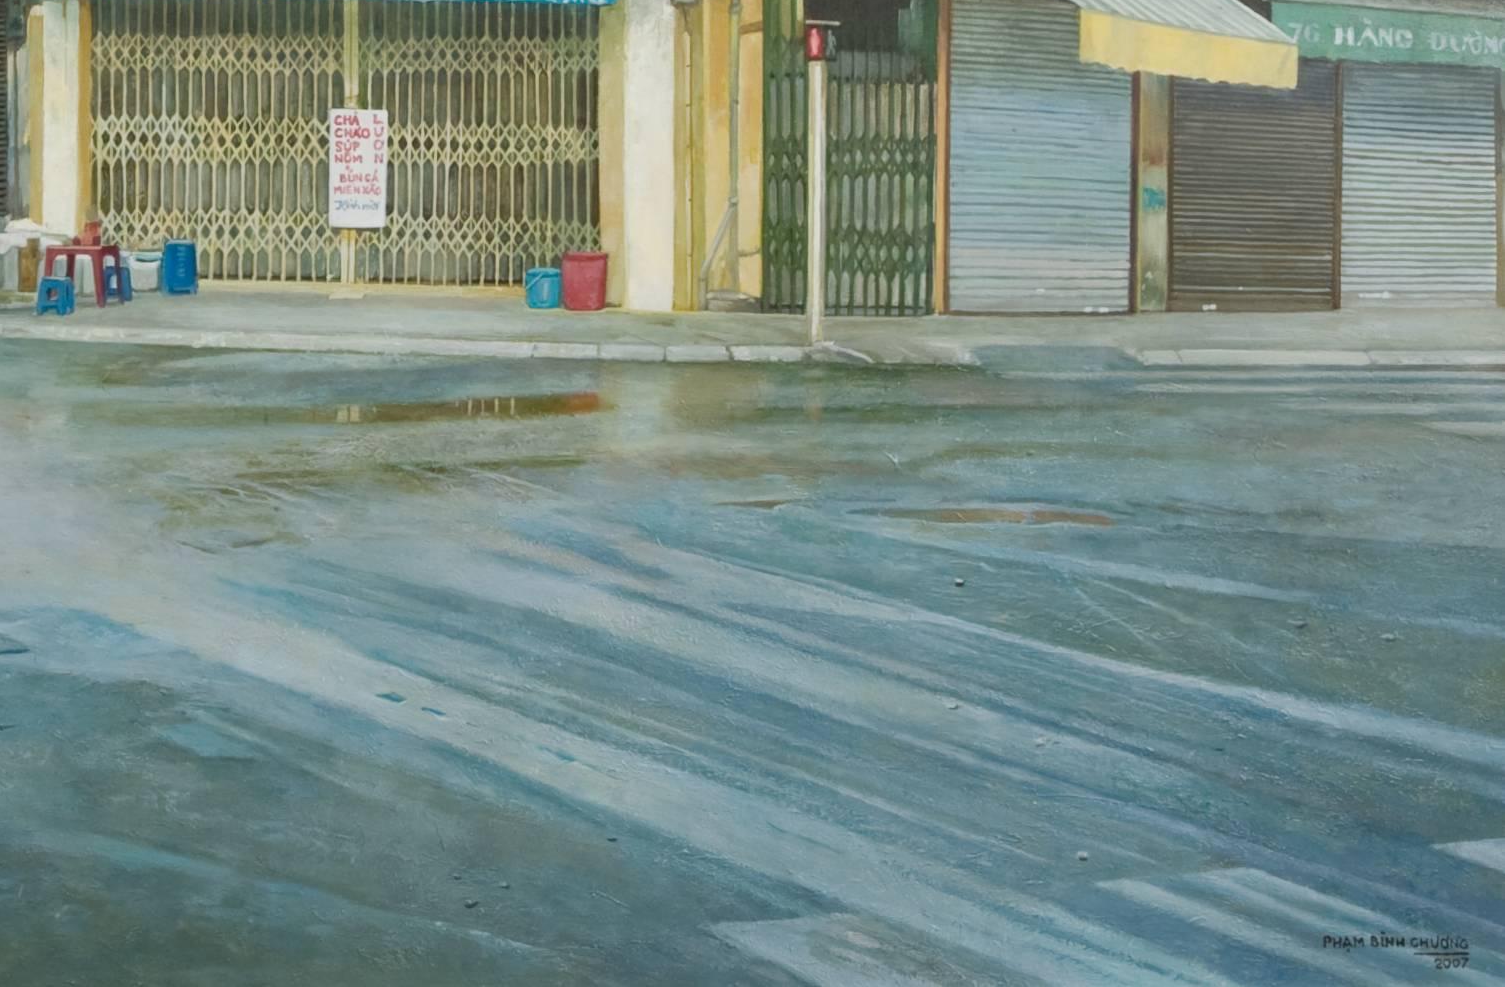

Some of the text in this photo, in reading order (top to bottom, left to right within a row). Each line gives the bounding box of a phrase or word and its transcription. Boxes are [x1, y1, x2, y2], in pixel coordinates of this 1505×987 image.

[1334, 17, 1413, 49] HÀNG
[1322, 935, 1365, 952] PHẠM
[1433, 956, 1470, 970] 2007
